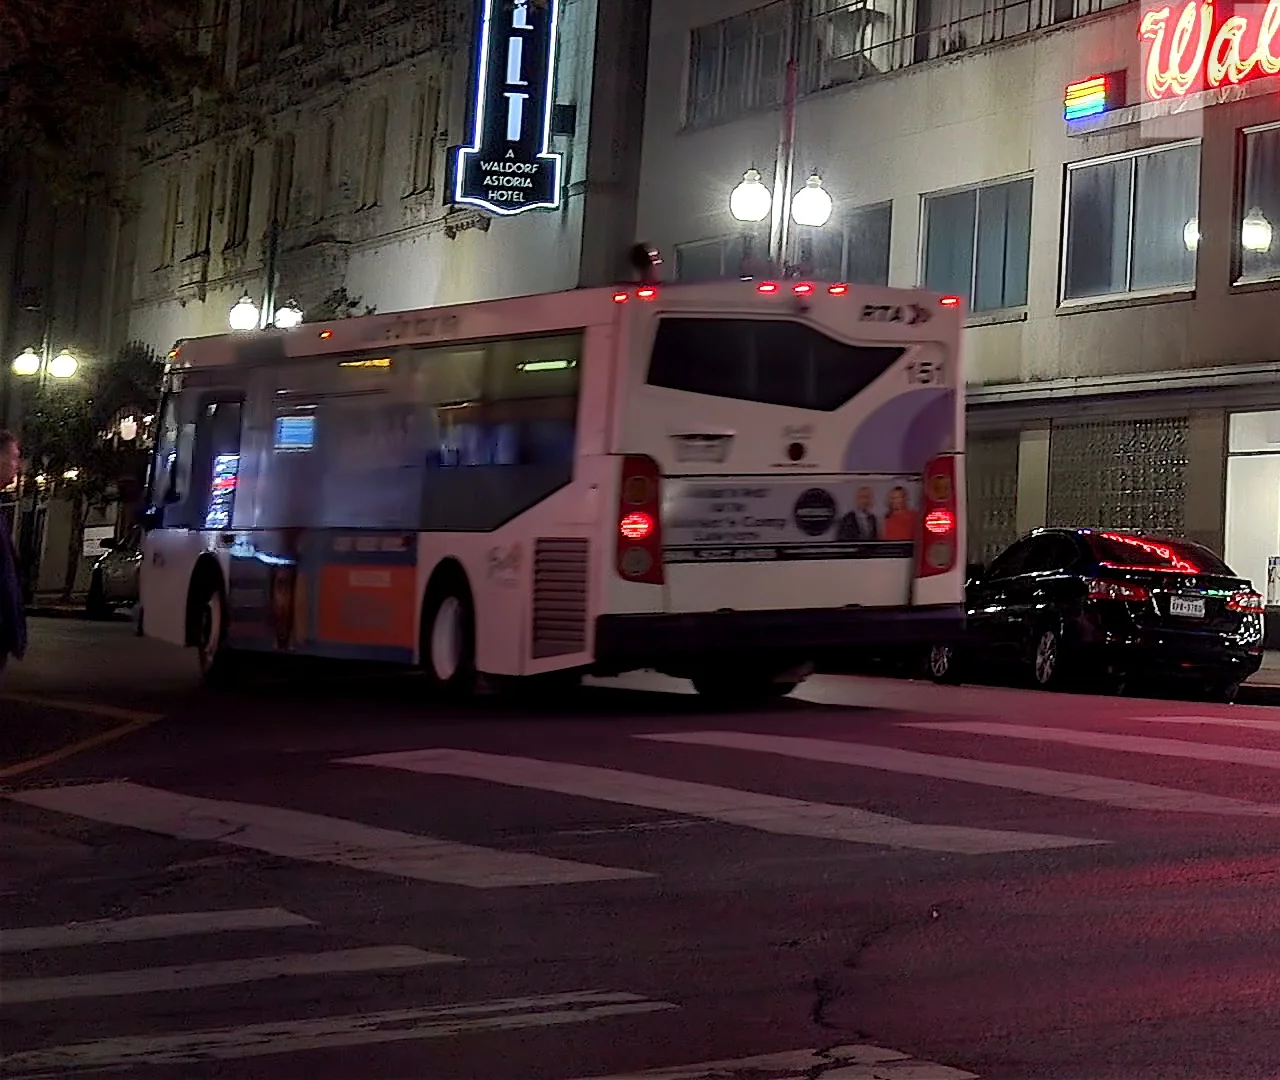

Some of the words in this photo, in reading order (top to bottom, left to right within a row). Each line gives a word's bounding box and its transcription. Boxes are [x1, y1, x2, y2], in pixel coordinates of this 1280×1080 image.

[504, 149, 515, 159] A
[480, 161, 539, 174] WALDORF
[483, 176, 533, 188] ASTORIA
[488, 190, 526, 202] HOTEL
